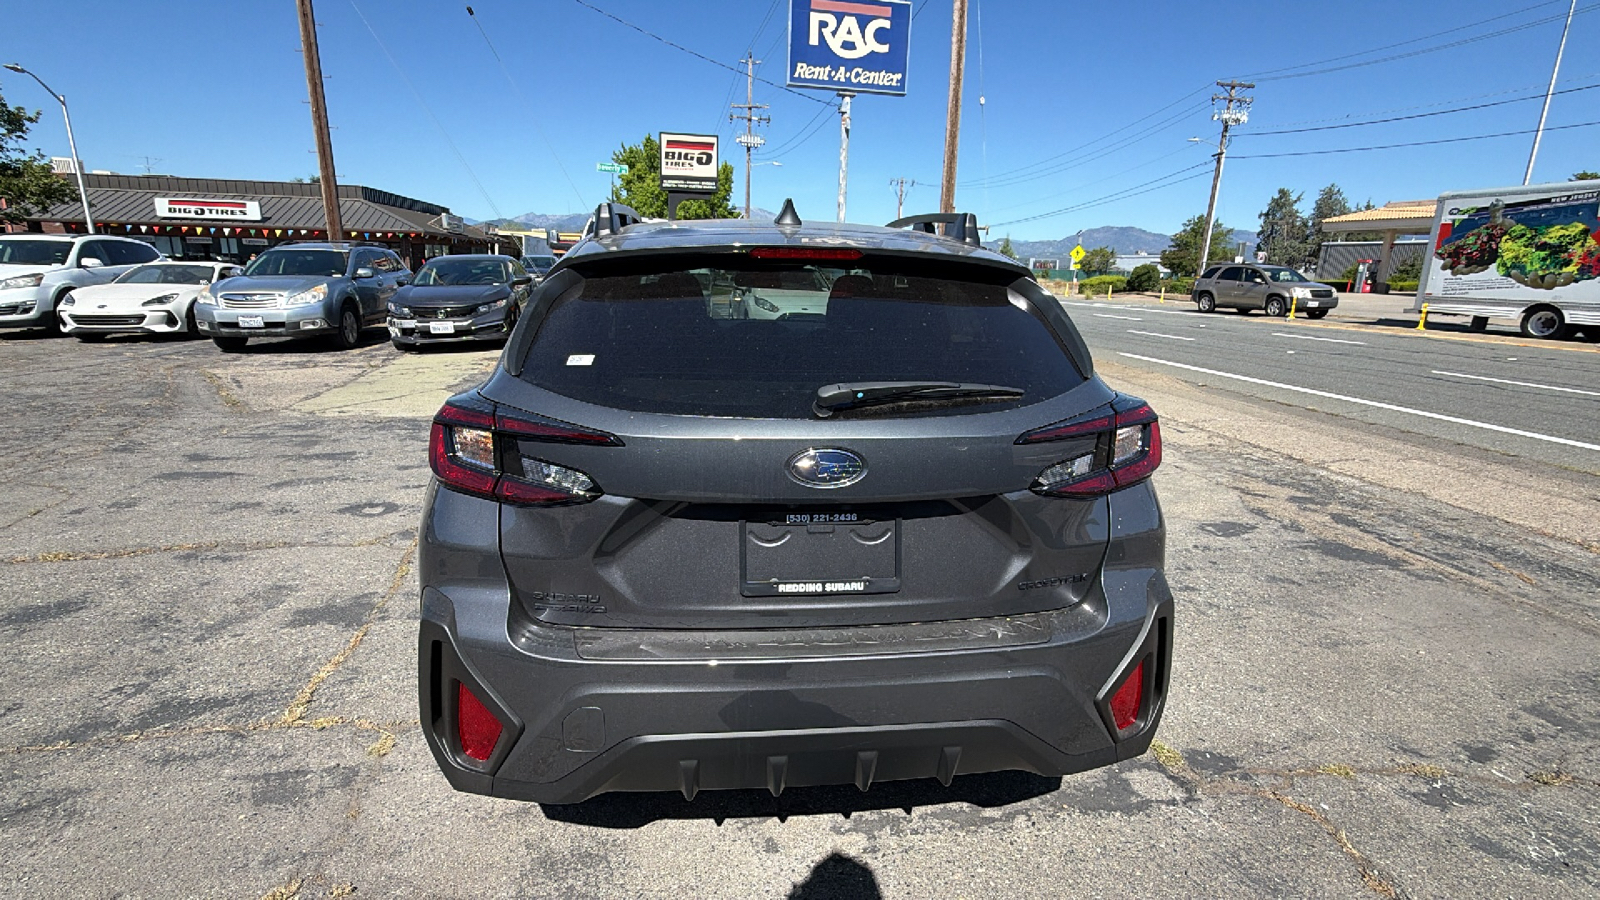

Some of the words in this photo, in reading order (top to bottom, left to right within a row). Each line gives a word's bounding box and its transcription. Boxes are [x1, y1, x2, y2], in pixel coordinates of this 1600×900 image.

[808, 11, 891, 59] RAC
[664, 151, 695, 161] BIG
[206, 208, 248, 216] TIRES
[786, 514, 811, 523] (530)
[812, 513, 858, 522] 221-2436
[778, 583, 823, 593] REDDING
[824, 582, 865, 592] SUBARU
[532, 591, 600, 604] SUBARU
